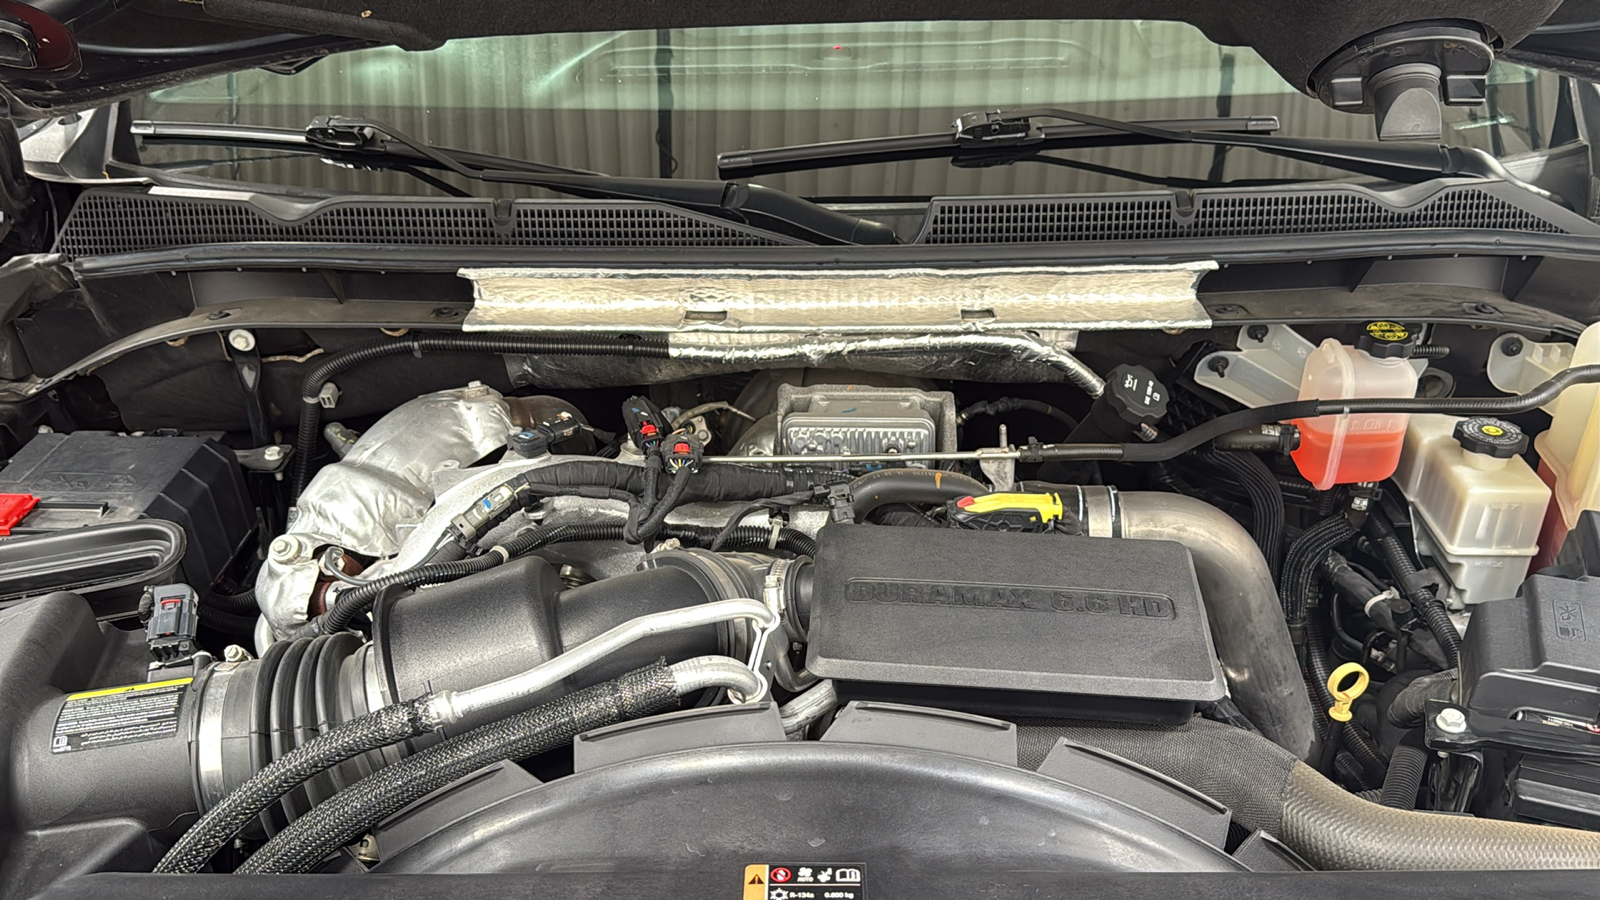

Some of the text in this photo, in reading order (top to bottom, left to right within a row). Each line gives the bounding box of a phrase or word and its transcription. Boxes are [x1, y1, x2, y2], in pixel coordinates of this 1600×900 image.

[850, 582, 1171, 618] DURAMAX 6.6 HD
